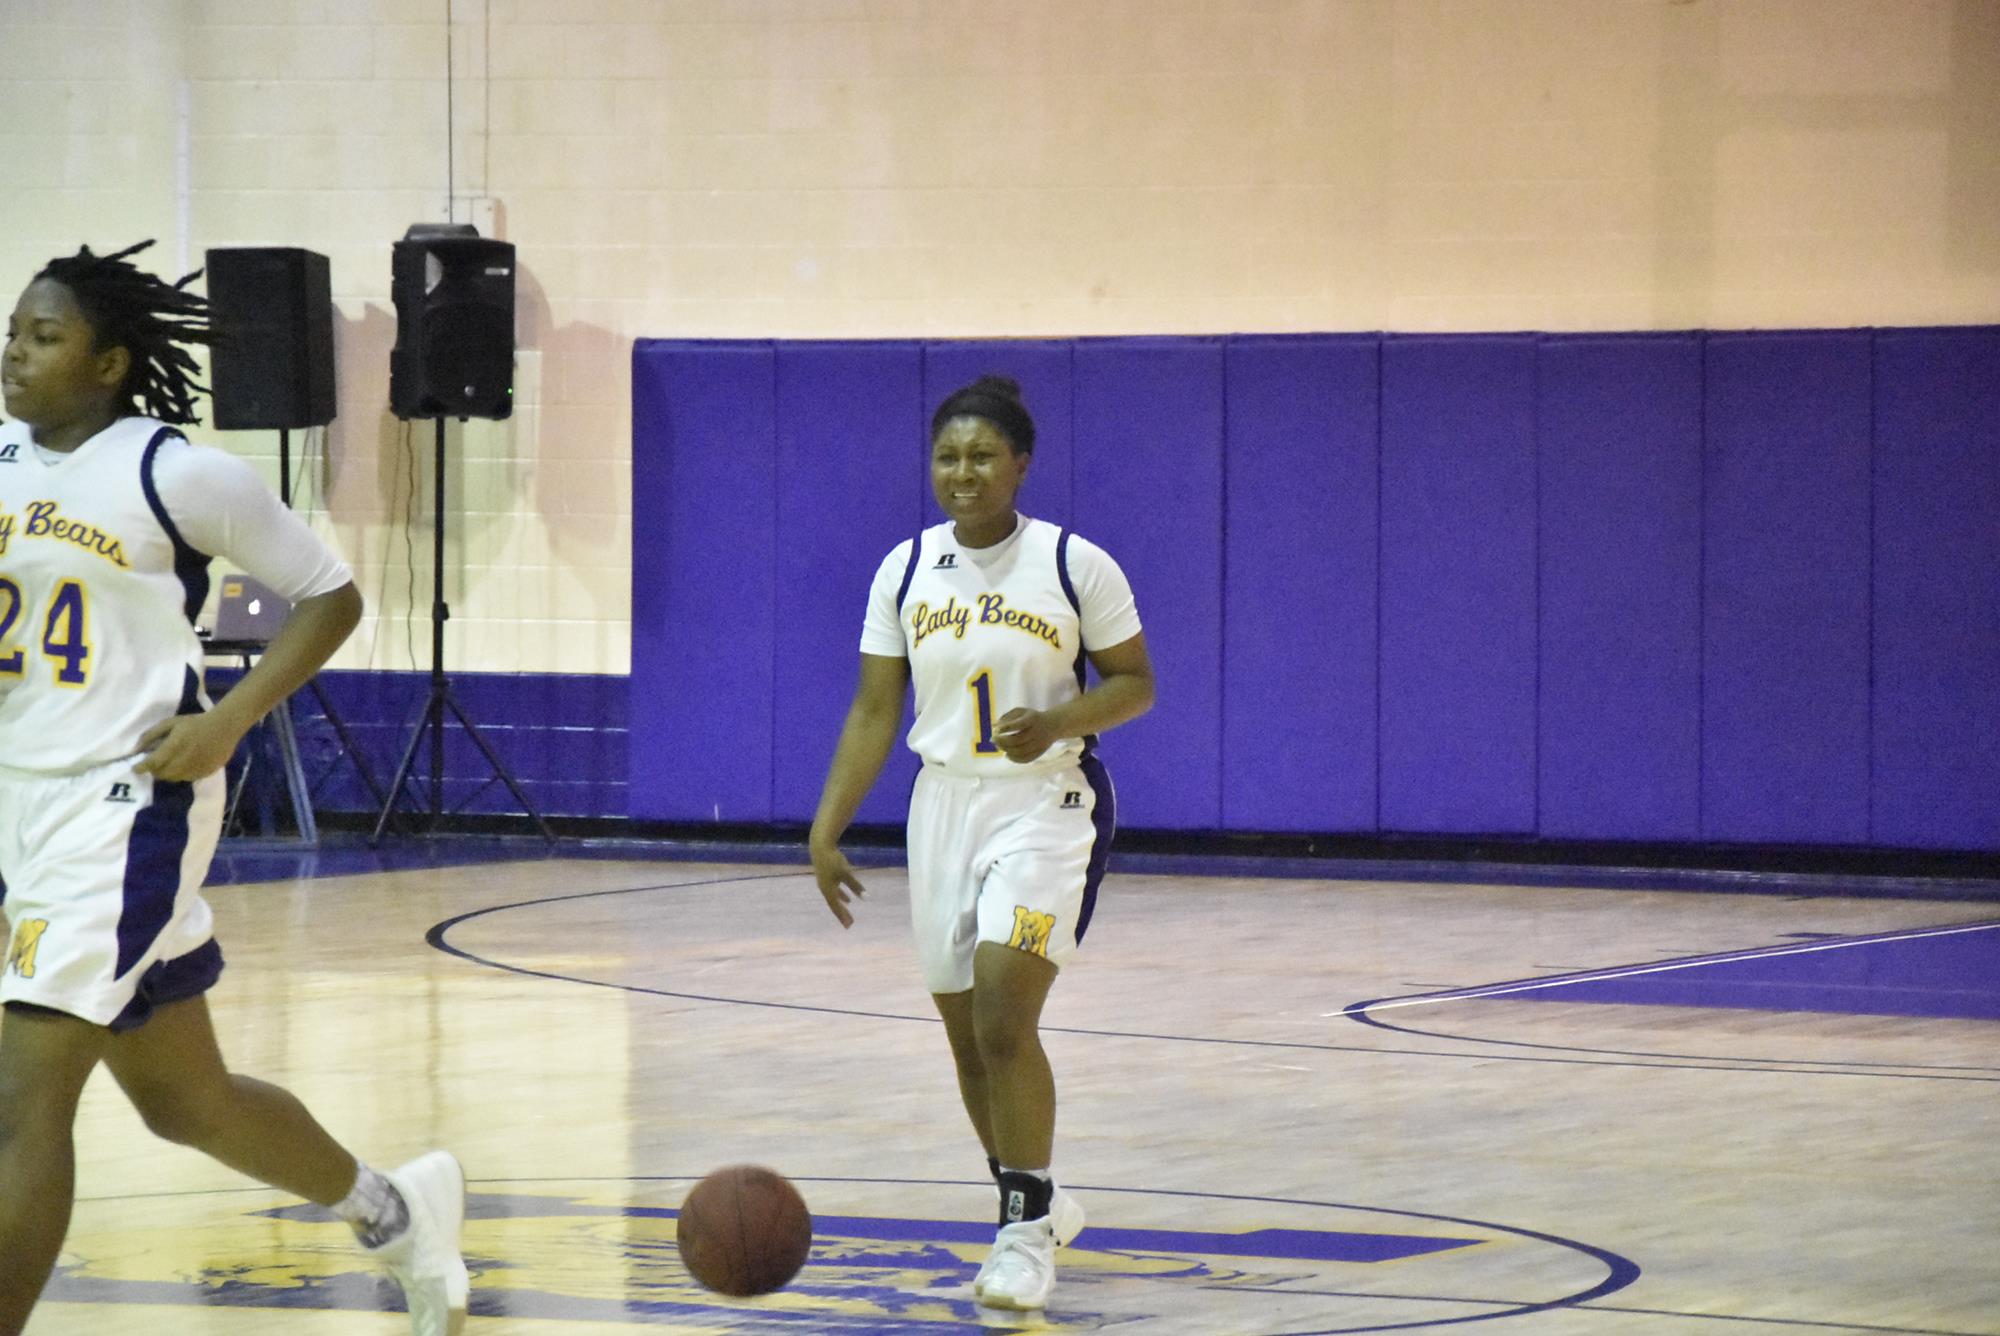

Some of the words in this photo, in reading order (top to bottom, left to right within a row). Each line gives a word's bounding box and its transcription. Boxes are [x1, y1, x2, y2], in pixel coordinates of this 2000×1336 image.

[26, 500, 130, 568] Bears
[912, 596, 971, 649] Lady
[978, 593, 1062, 650] Bears
[968, 669, 1004, 757] 1
